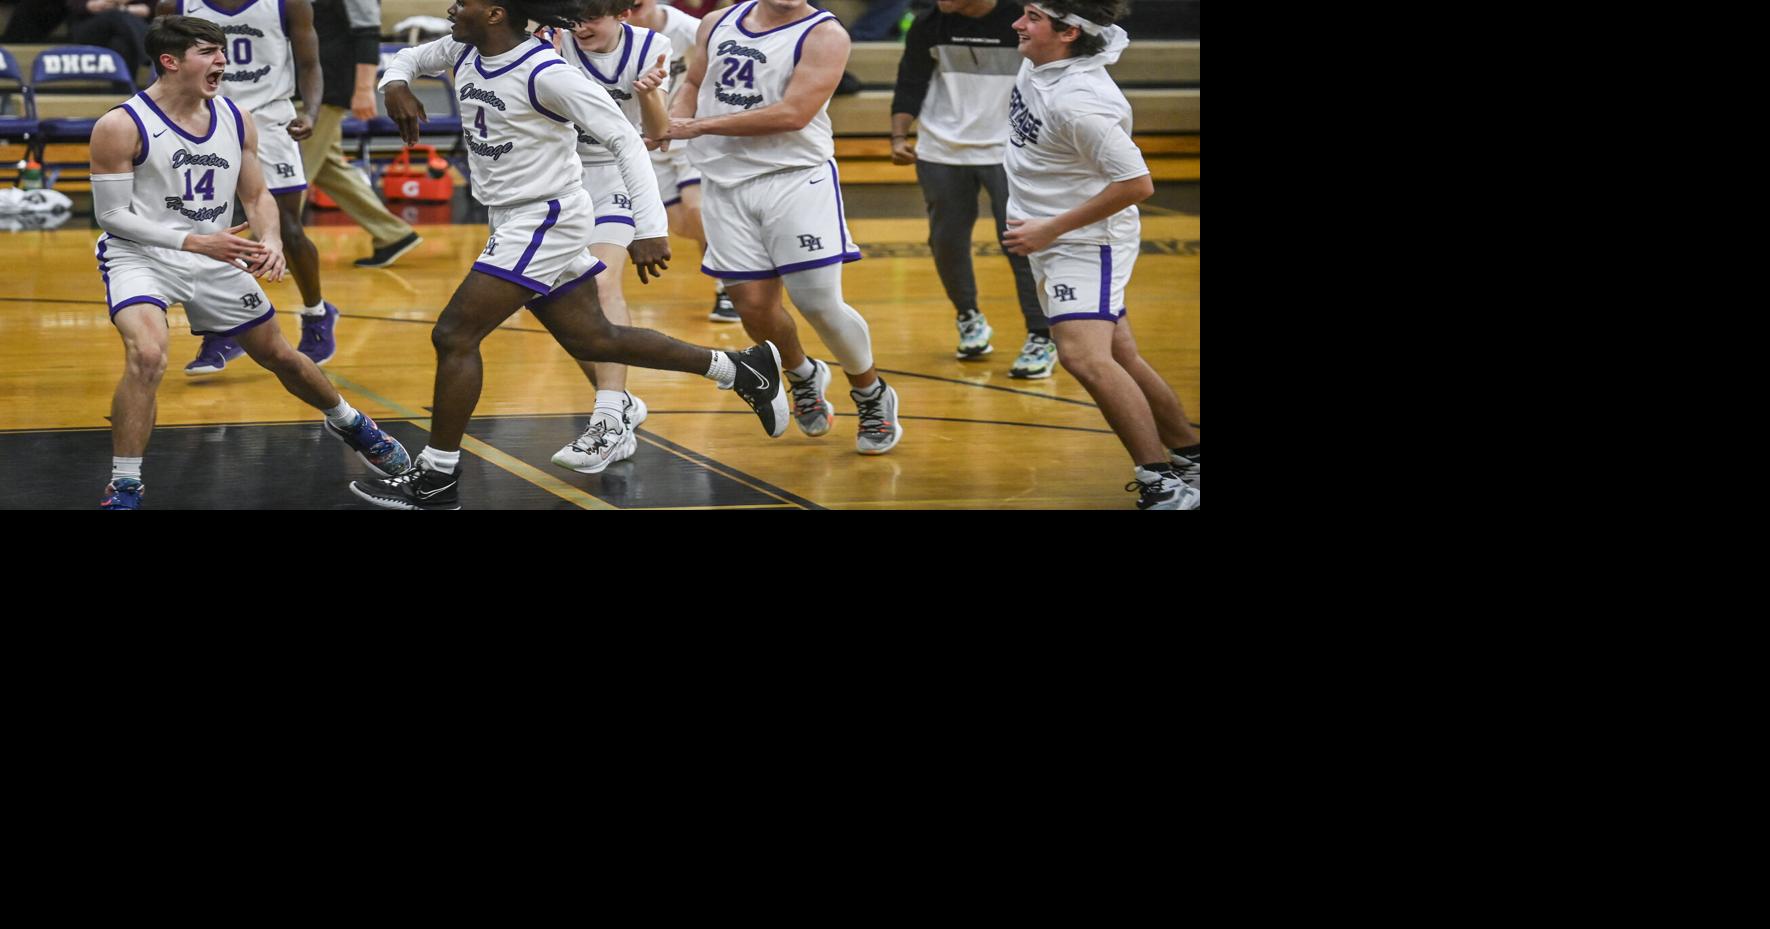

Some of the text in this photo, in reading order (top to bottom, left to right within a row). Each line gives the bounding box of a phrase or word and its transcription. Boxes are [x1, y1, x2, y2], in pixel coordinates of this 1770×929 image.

[43, 54, 116, 74] DHCA
[721, 57, 754, 89] 24
[474, 105, 488, 139] 4
[172, 149, 230, 169] Decatur
[182, 169, 215, 201] 14
